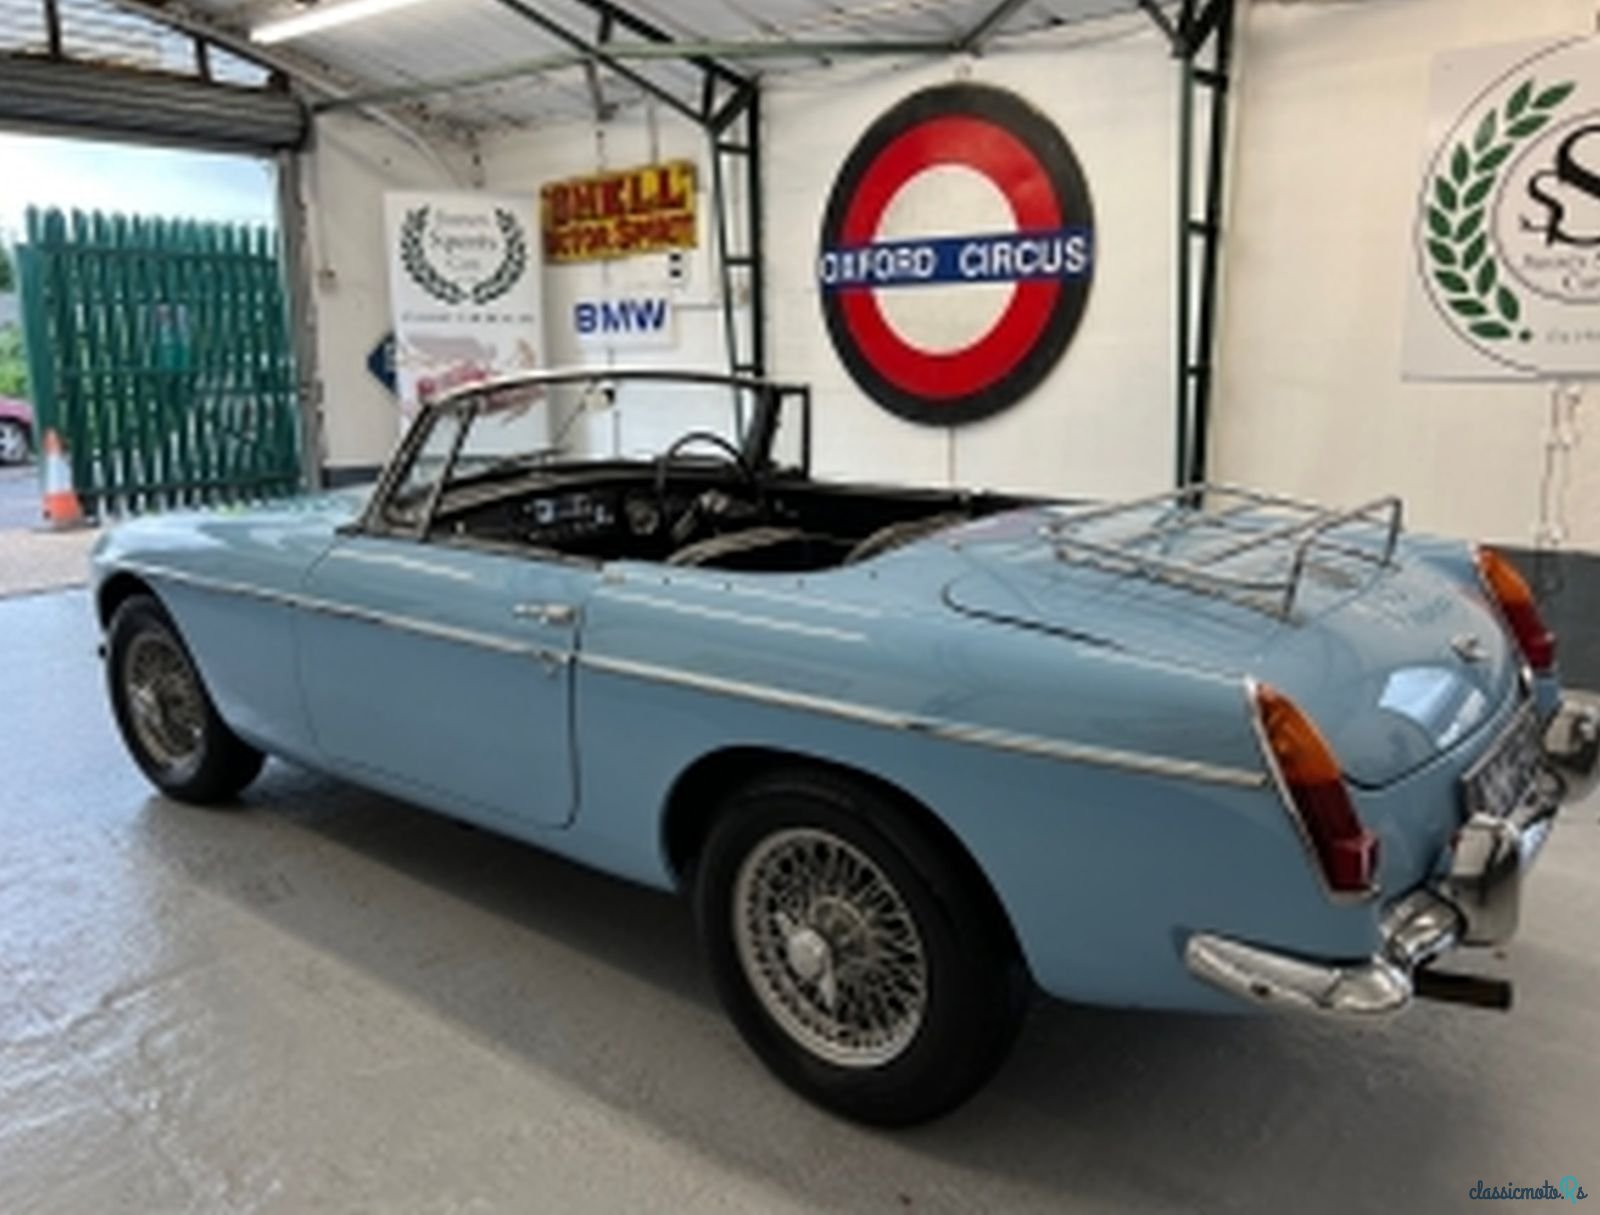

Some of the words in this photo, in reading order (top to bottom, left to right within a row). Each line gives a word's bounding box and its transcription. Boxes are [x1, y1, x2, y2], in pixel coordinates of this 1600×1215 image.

[820, 247, 938, 284] OXFORD
[958, 236, 1088, 278] CIRCUS
[574, 299, 666, 334] BMW
